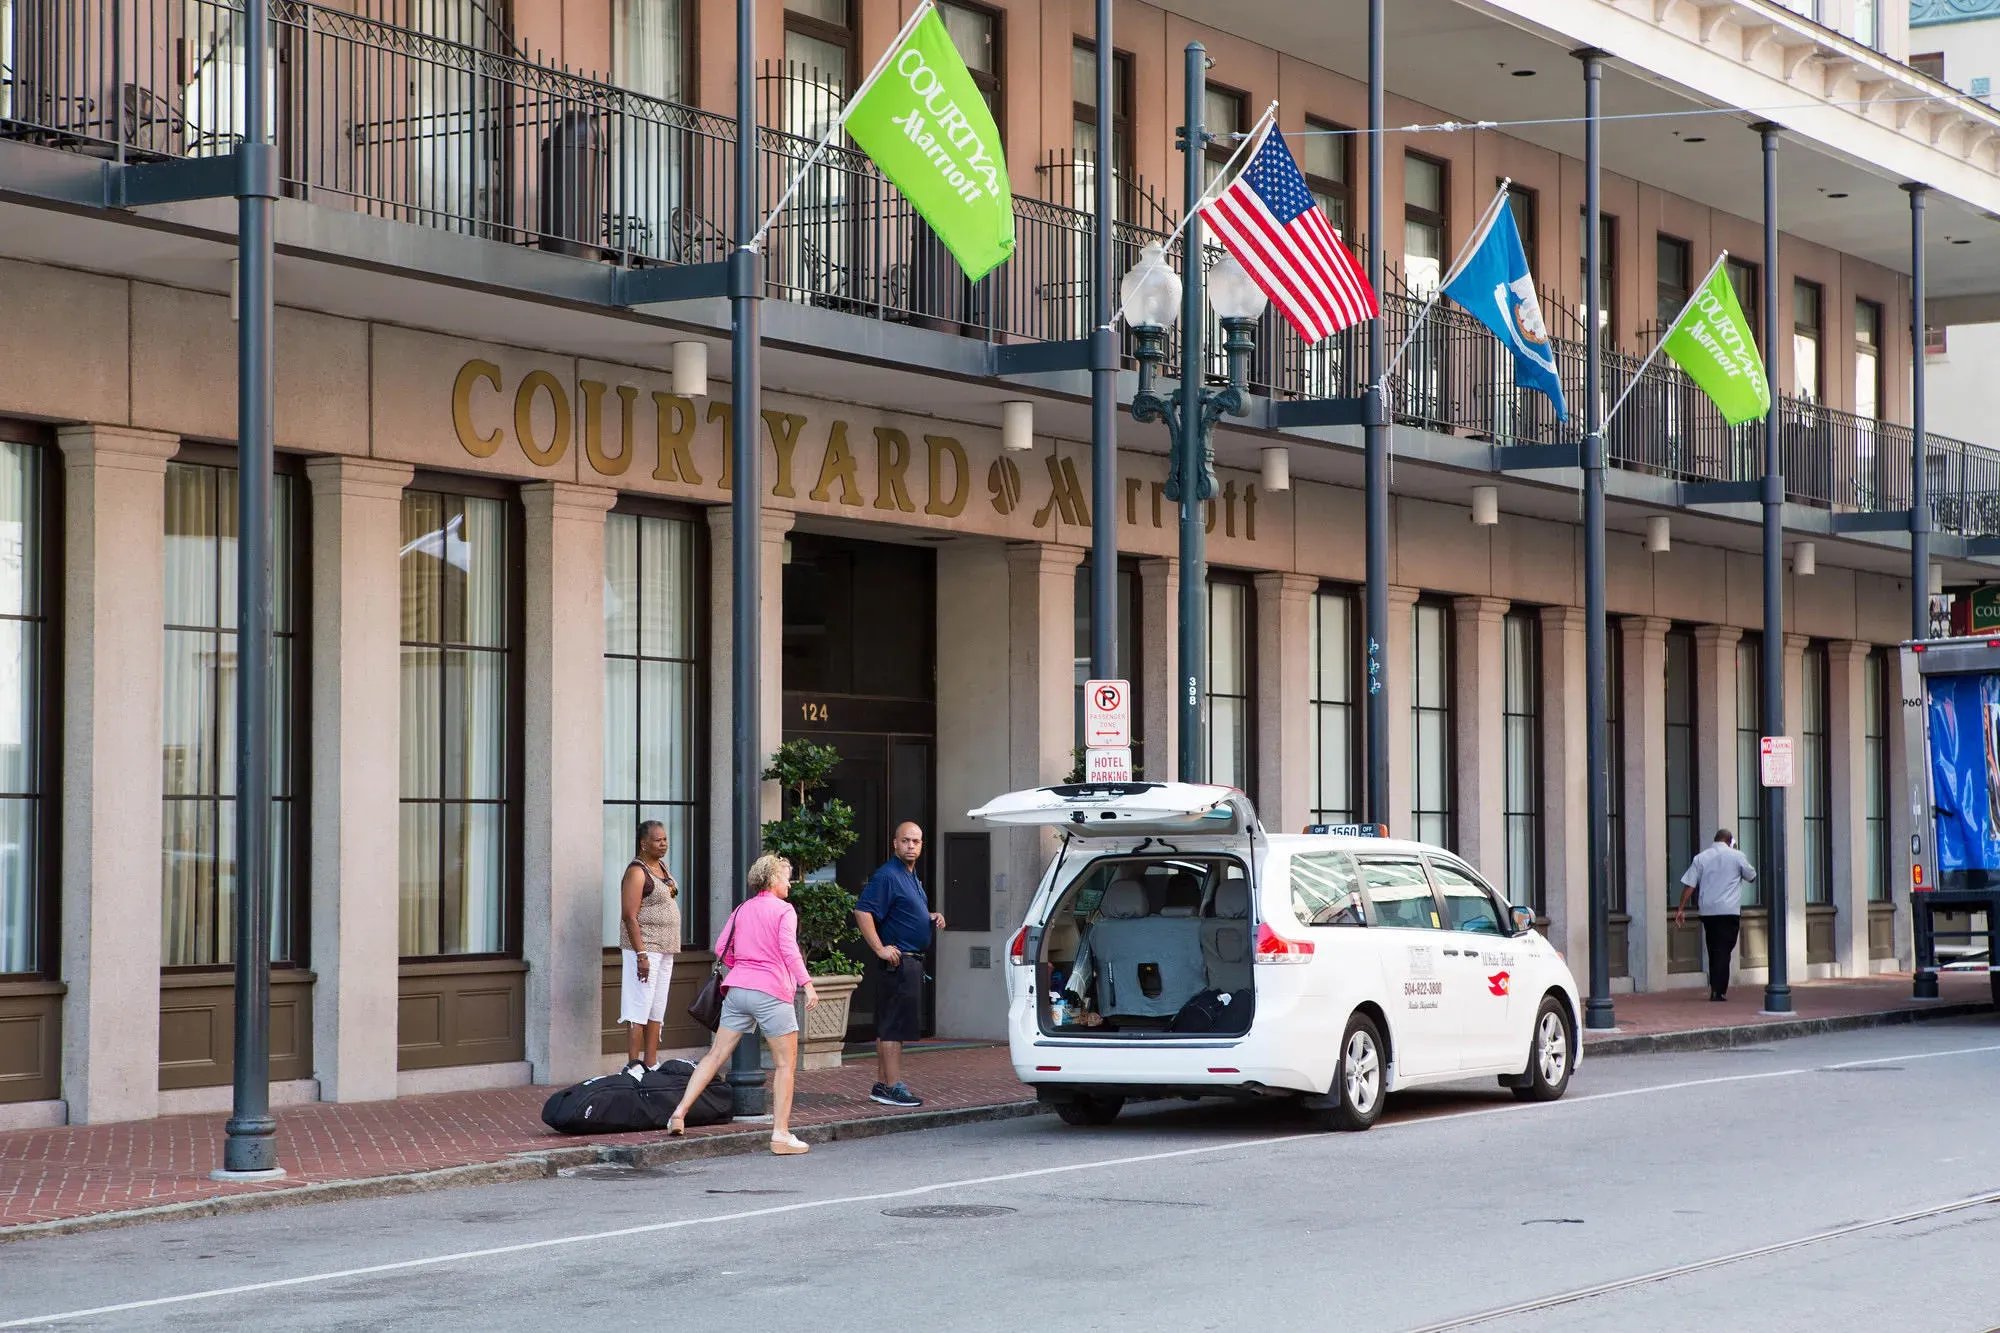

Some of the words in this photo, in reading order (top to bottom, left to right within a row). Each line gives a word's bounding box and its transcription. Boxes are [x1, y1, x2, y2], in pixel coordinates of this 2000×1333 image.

[898, 49, 999, 204] COURTYA
[892, 108, 982, 203] Marriott
[1684, 320, 1741, 377] Marriott
[452, 359, 970, 518] COURTYARD
[1032, 454, 1258, 541] Mrrtt
[802, 703, 828, 721] 124
[1091, 771, 1128, 781] PARKING
[1094, 757, 1123, 767] HOTEL
